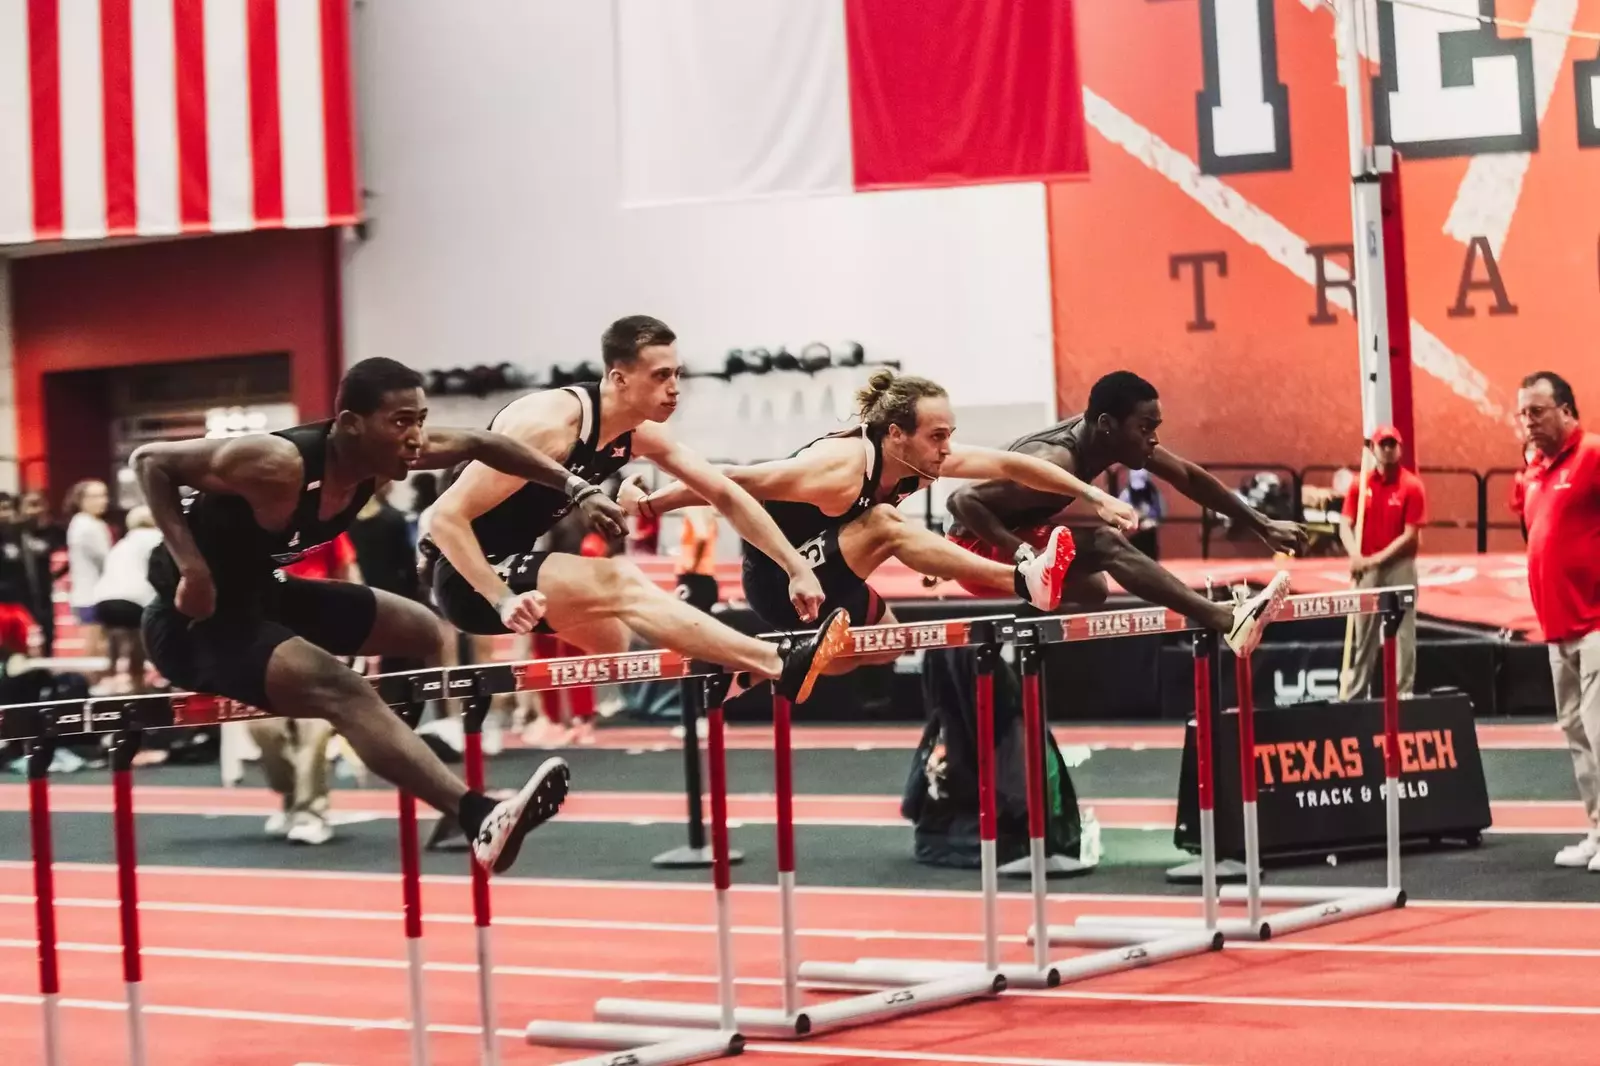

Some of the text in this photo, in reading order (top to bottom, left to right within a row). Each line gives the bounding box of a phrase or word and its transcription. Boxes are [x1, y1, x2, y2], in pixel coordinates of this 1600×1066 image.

[1168, 232, 1600, 332] TRA
[1292, 597, 1331, 618] TEXAS
[851, 627, 907, 653] TEXAS
[908, 623, 947, 648] TECH
[1086, 613, 1131, 637] TEXAS
[548, 659, 611, 686] TEXAS
[613, 653, 662, 680] TECH
[1253, 736, 1364, 785] TEXAS
[1295, 779, 1430, 808] TRACK & FELD
